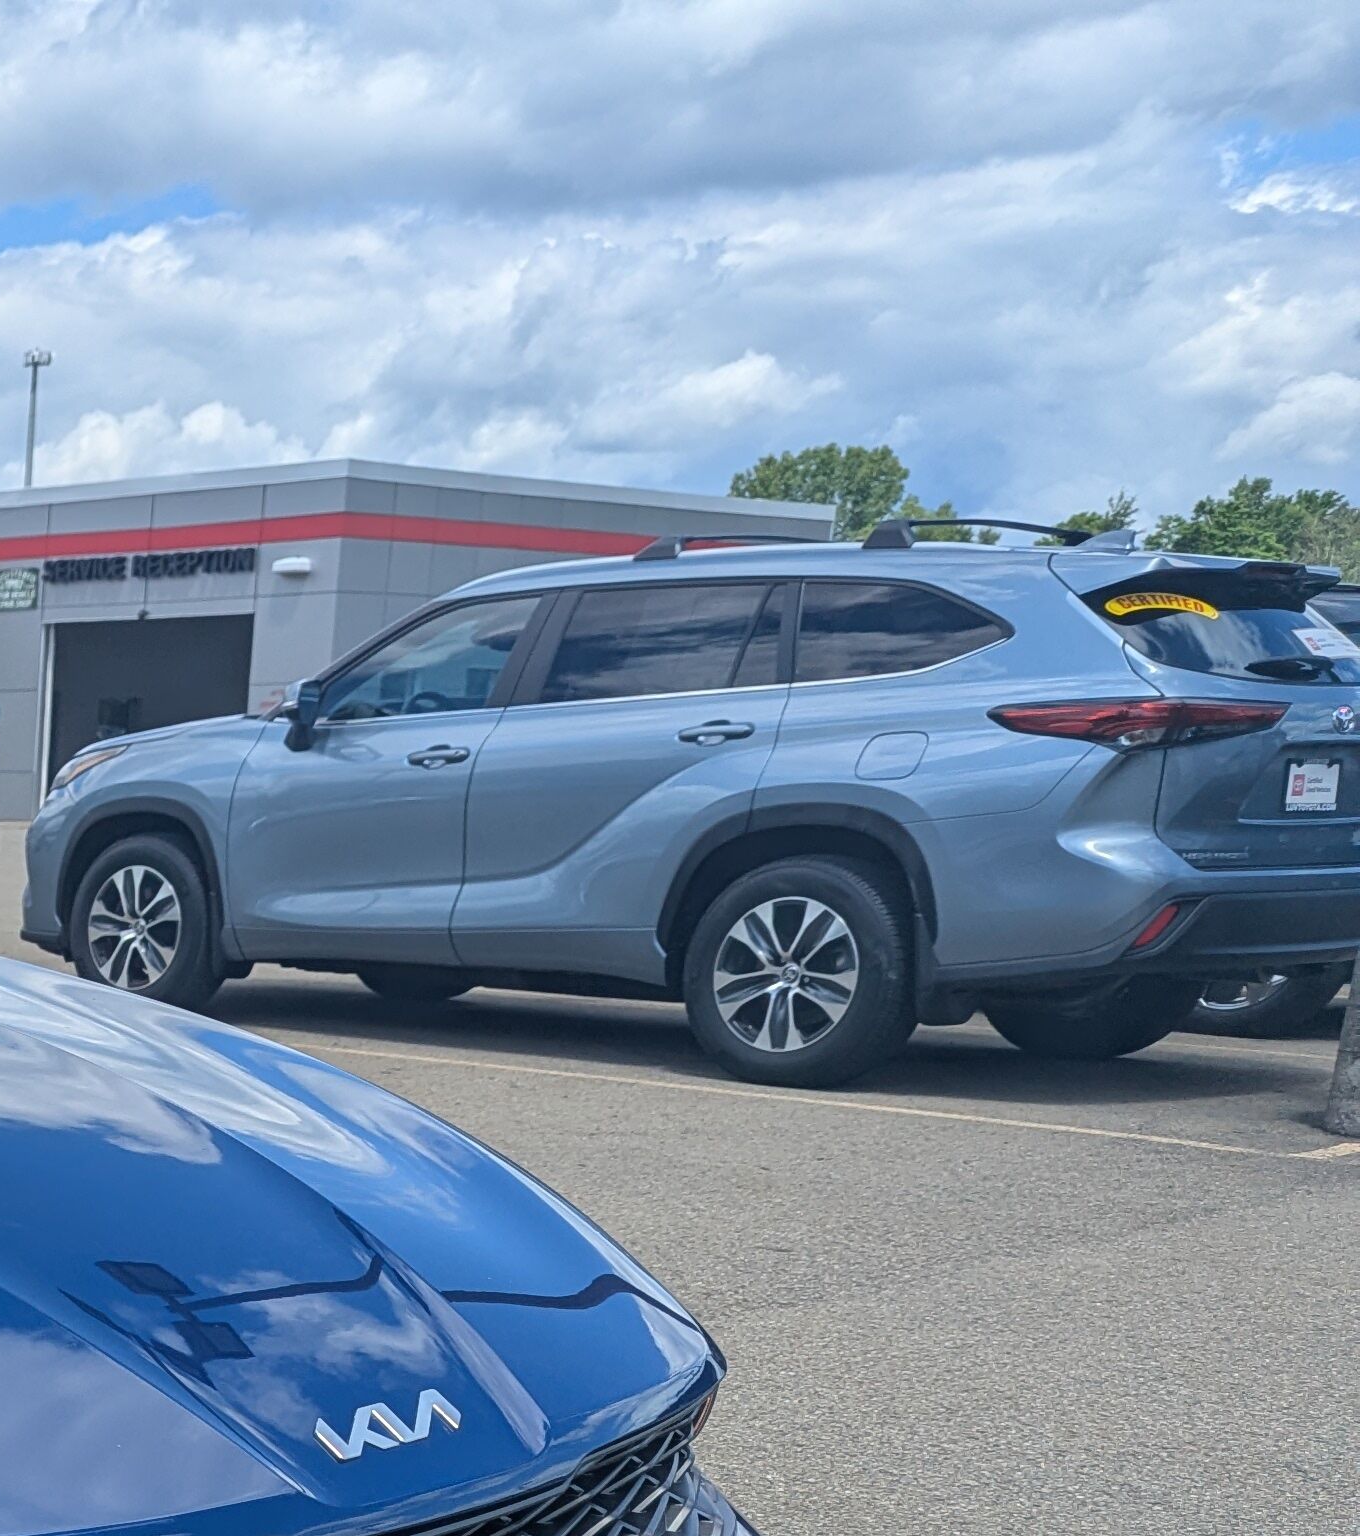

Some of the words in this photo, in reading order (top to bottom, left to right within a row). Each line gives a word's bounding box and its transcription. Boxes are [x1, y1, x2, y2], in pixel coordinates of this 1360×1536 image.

[42, 556, 128, 583] SERVICE
[131, 548, 256, 579] RECEPTION
[1118, 594, 1205, 613] CERTIFIED
[314, 1388, 462, 1460] KIA
